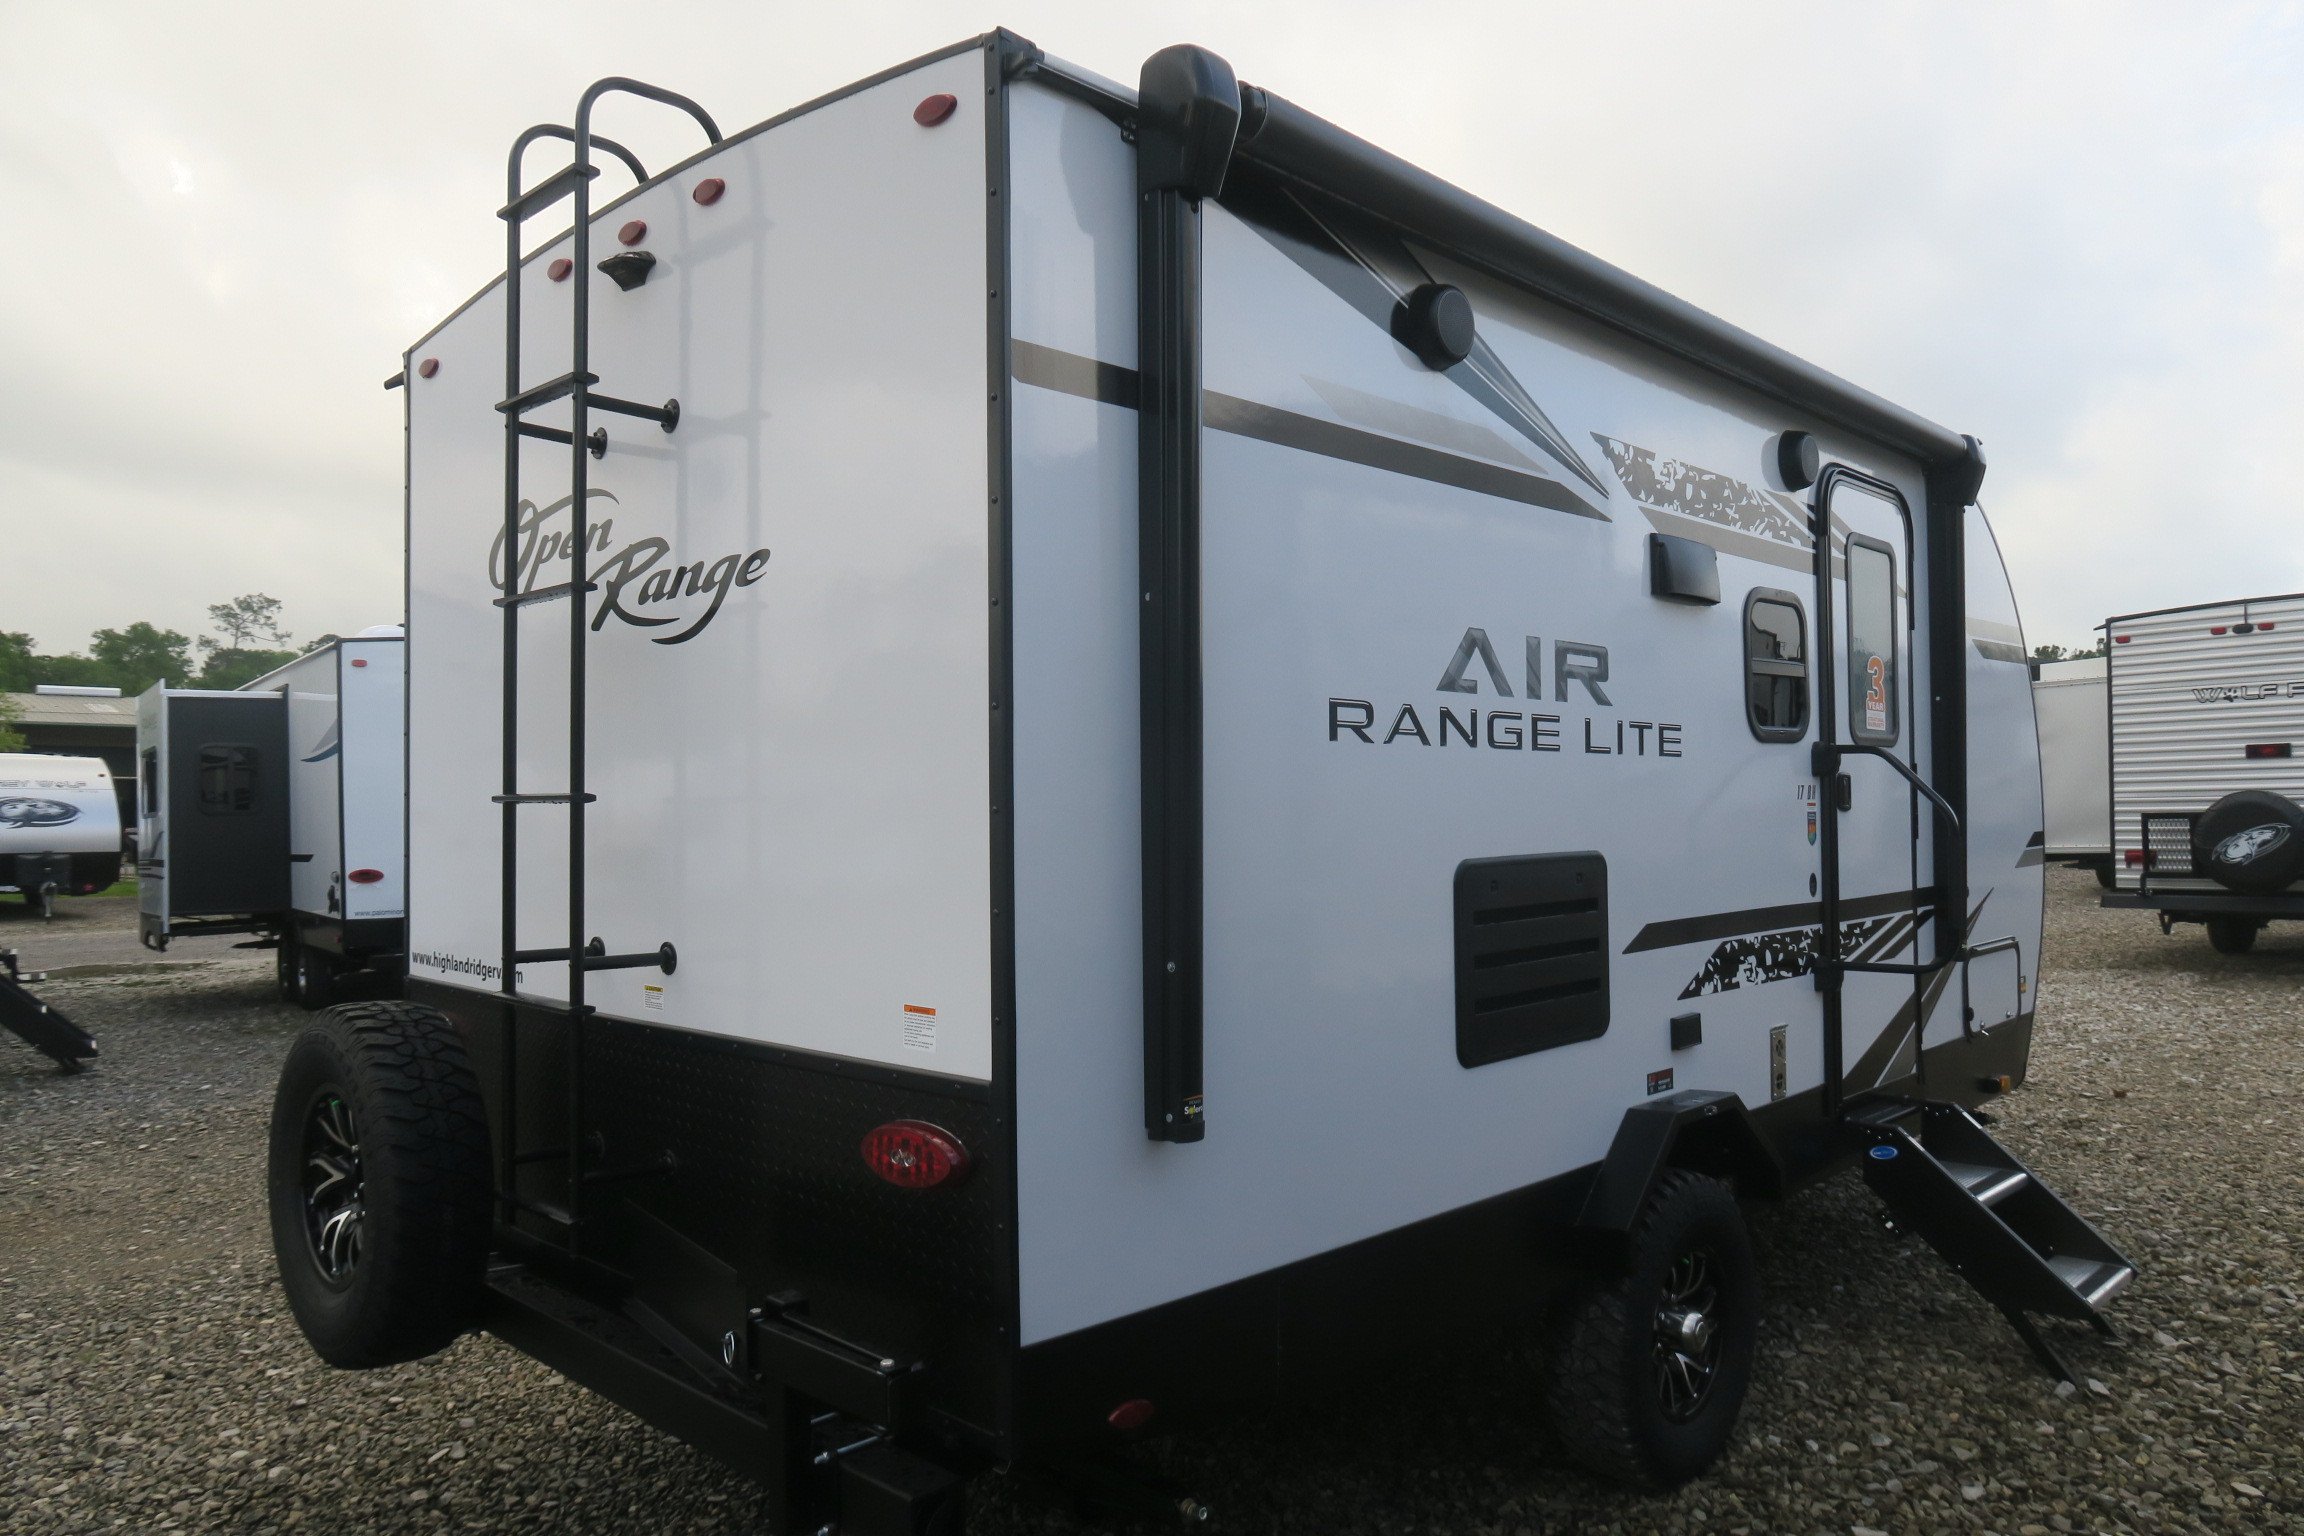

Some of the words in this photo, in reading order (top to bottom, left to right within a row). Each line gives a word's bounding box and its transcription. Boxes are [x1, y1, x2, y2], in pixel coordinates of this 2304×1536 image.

[489, 488, 619, 594] Open
[587, 537, 771, 645] Range
[1436, 627, 1613, 707] AIR
[1867, 656, 1885, 703] 3
[1329, 697, 1560, 752] RANGE
[1584, 717, 1683, 758] LITE
[1868, 701, 1884, 711] YEAR
[412, 951, 523, 984] www.highlandridgervm
